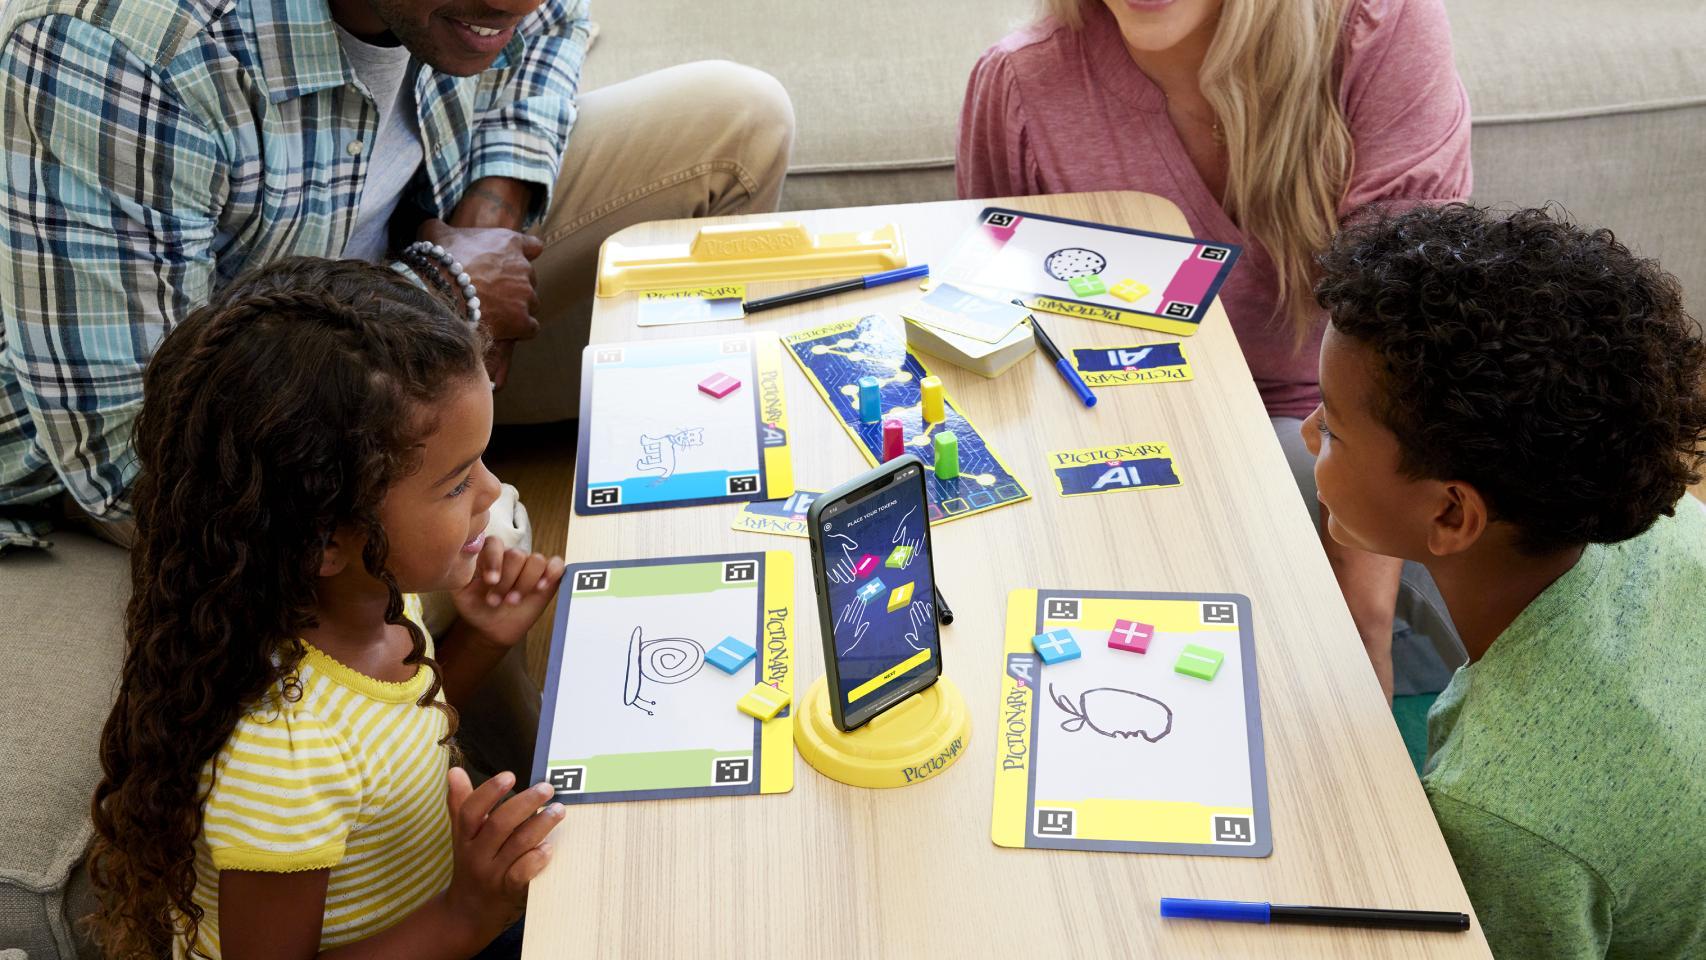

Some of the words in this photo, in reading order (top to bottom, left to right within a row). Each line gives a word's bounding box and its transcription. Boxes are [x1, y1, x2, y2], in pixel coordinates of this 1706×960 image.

[704, 234, 796, 256] PICTIONARY
[1038, 300, 1121, 320] PICTIONARY
[1107, 347, 1154, 366] AI
[1085, 369, 1187, 383] PICTIONARY
[760, 370, 782, 423] PICTIONARY
[763, 428, 784, 444] AI
[1056, 445, 1165, 464] PICTIONARY
[1091, 466, 1142, 489] AI
[847, 516, 864, 528] PLACE
[863, 509, 878, 519] YOUR
[878, 499, 898, 513] TOKENS
[744, 517, 808, 533] IONARY
[766, 607, 789, 683] PICTIONARY
[1009, 657, 1033, 683] AI
[1003, 686, 1027, 771] PICTIONARY
[902, 736, 963, 783] PICTIONARY
